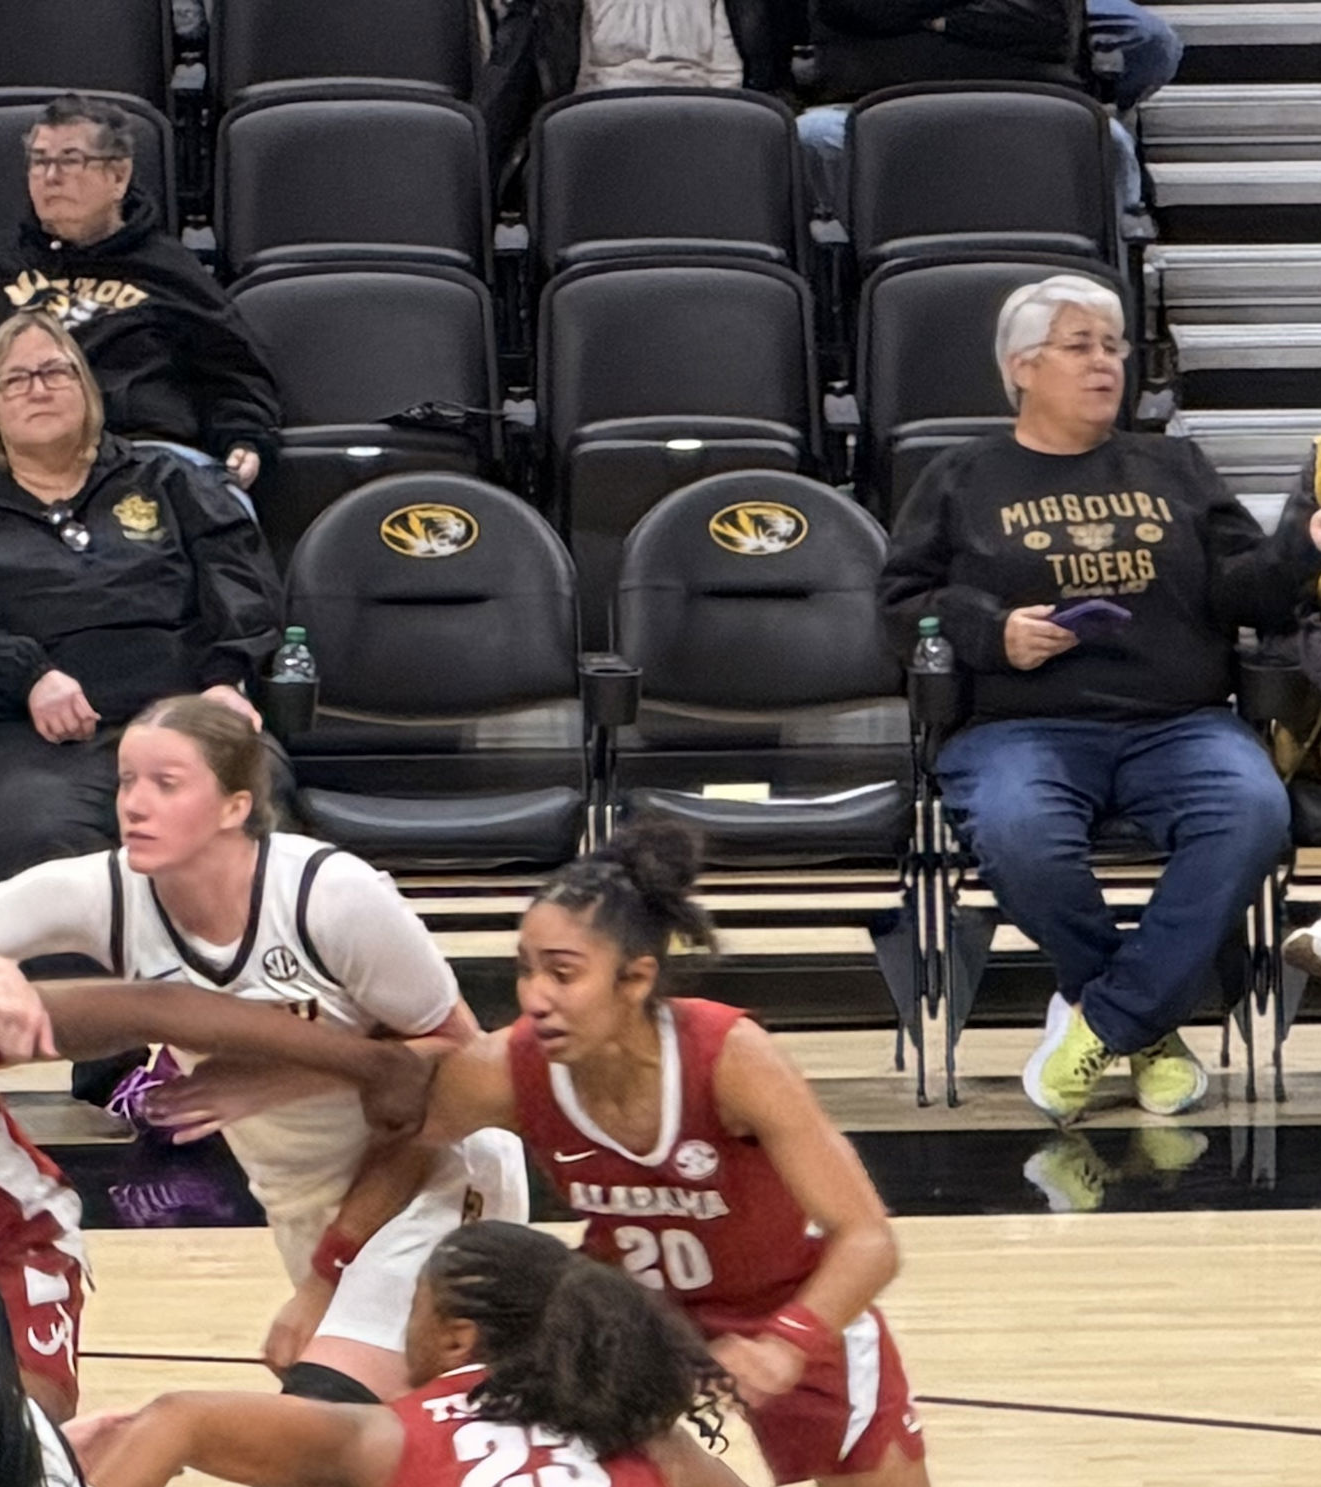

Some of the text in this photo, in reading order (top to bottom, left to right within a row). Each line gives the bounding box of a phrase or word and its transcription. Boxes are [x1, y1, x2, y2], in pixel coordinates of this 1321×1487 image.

[1000, 491, 1174, 536] MISSOURI
[1044, 549, 1156, 585] TIGERS
[613, 1225, 713, 1290] 20
